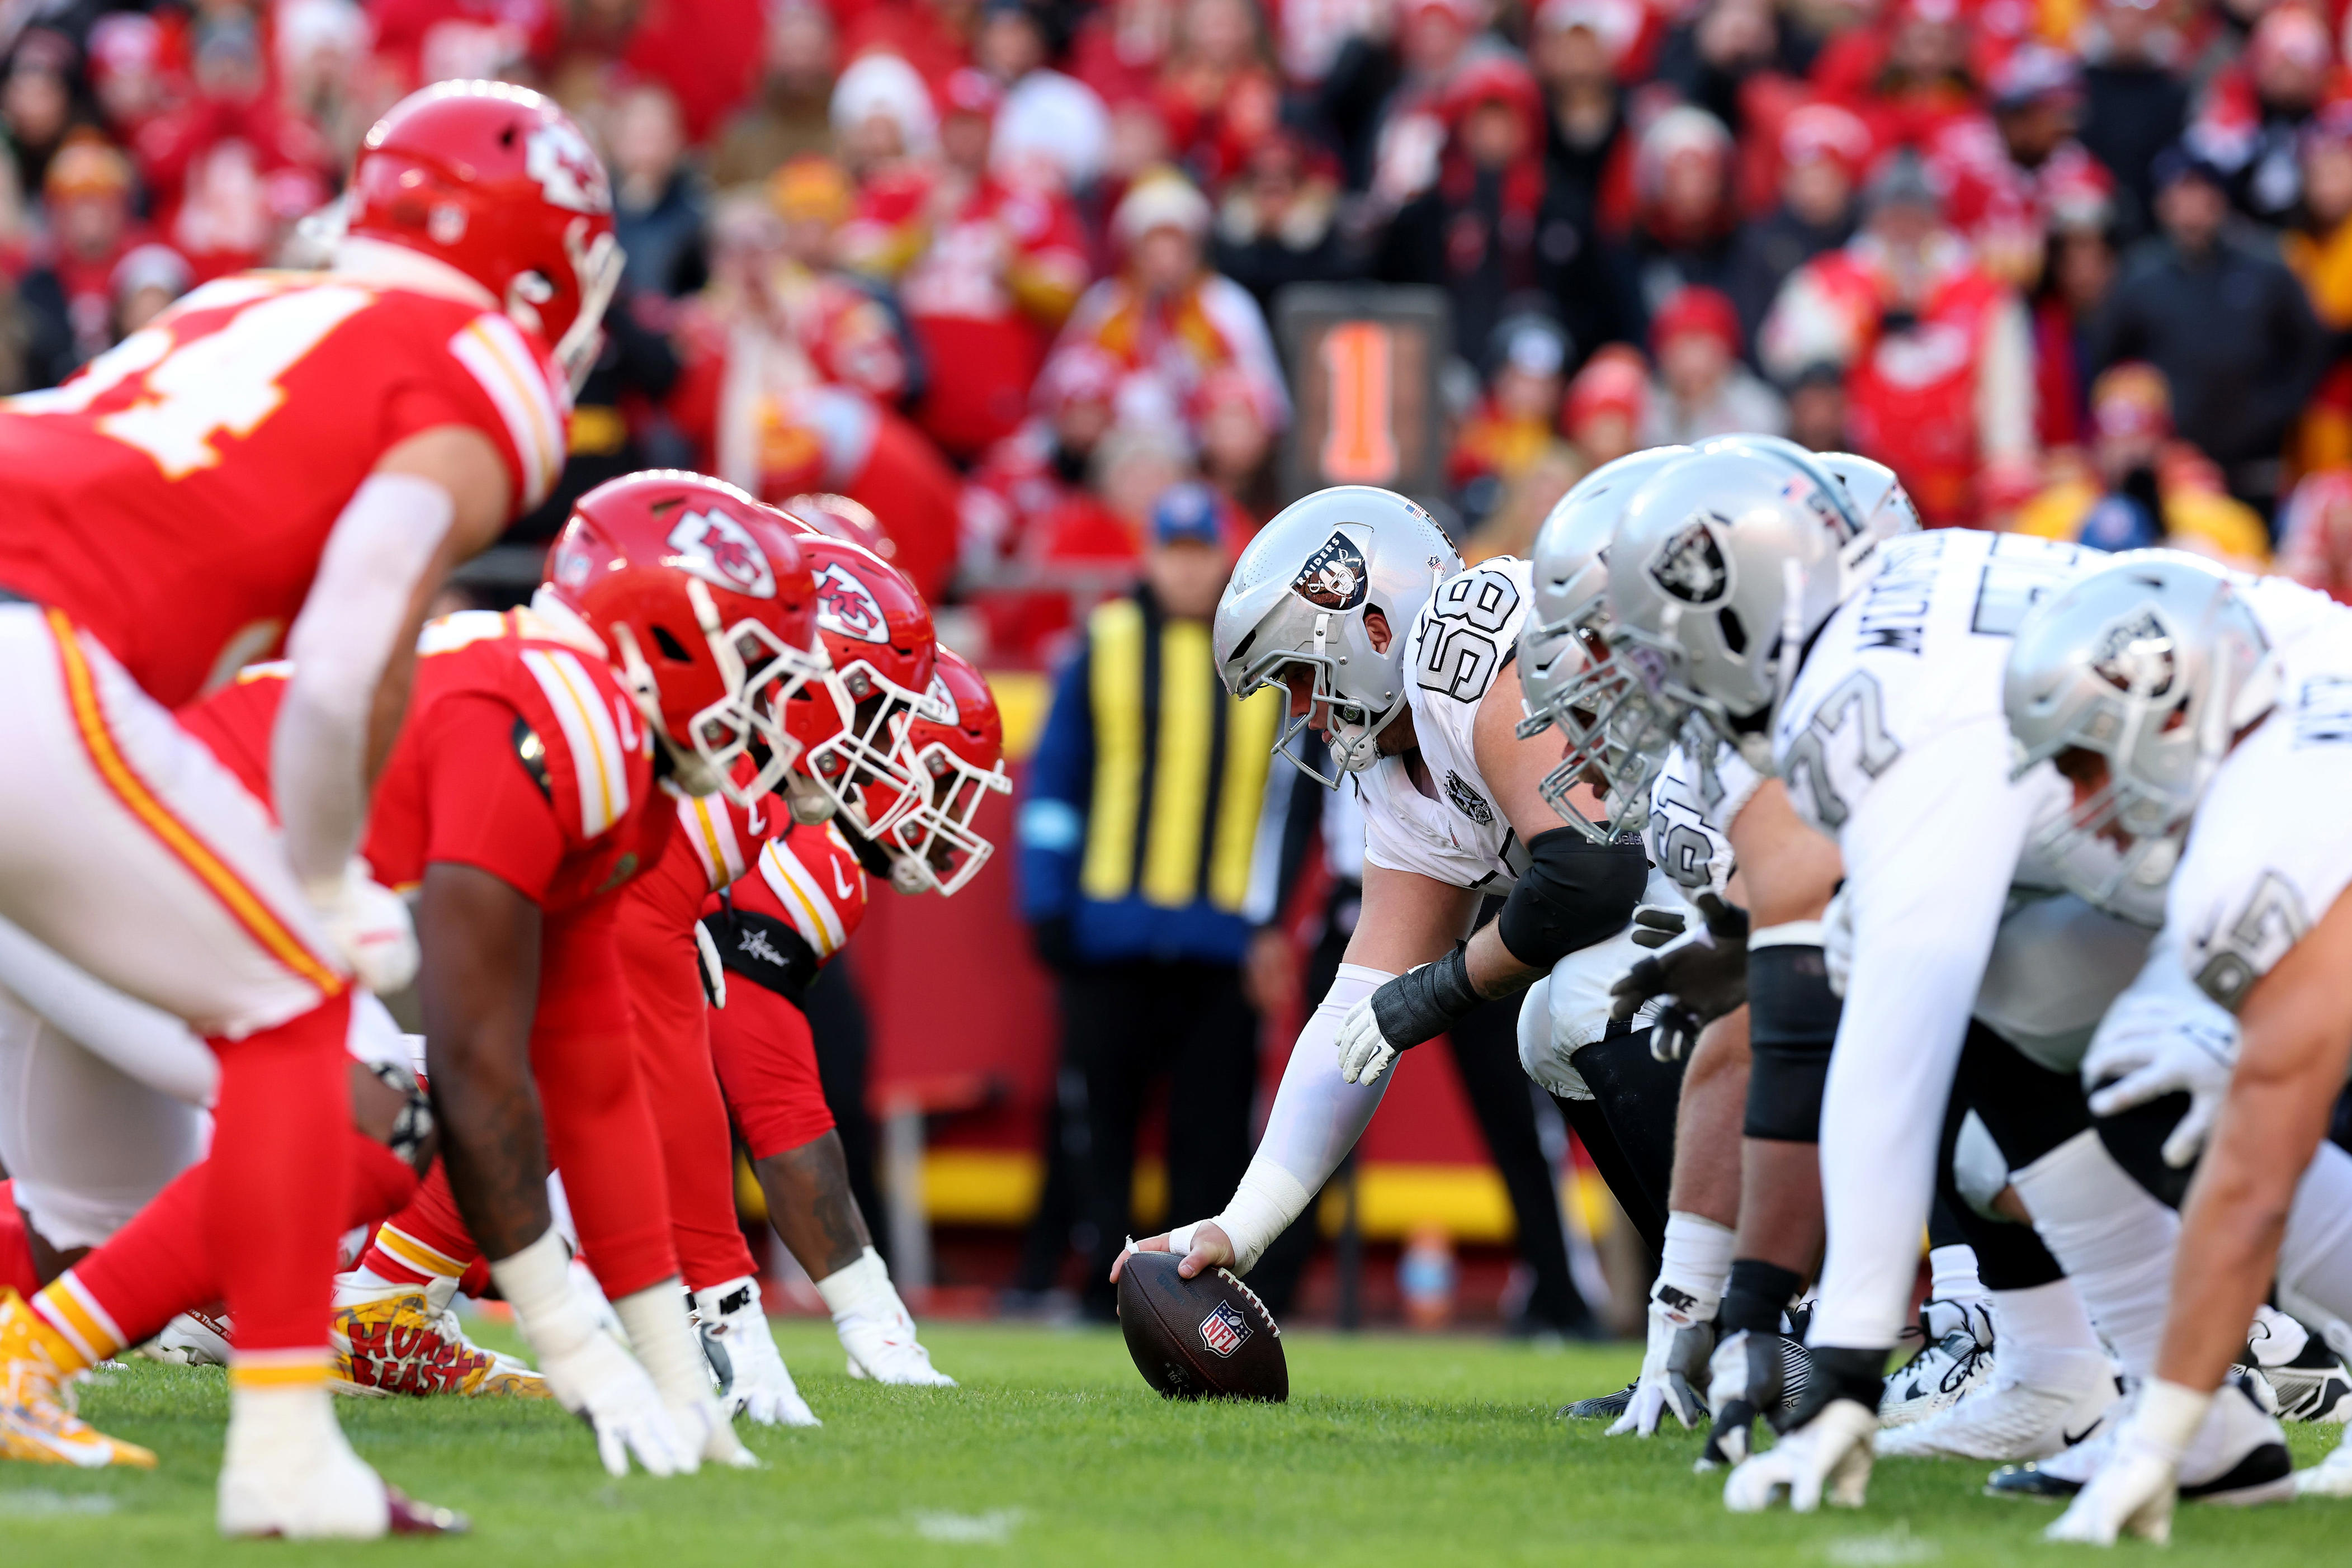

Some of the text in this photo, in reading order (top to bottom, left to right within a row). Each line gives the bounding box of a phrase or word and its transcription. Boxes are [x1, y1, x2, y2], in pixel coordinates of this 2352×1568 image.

[1320, 320, 1398, 482] 1
[1296, 537, 1340, 586] RAIDERS
[816, 575, 879, 636] KC
[1416, 569, 1520, 704] 58
[1783, 669, 1905, 830] 77
[348, 1322, 486, 1368] HUMBLE
[1203, 1316, 1236, 1353] NFL
[351, 1356, 473, 1395] BEAST
